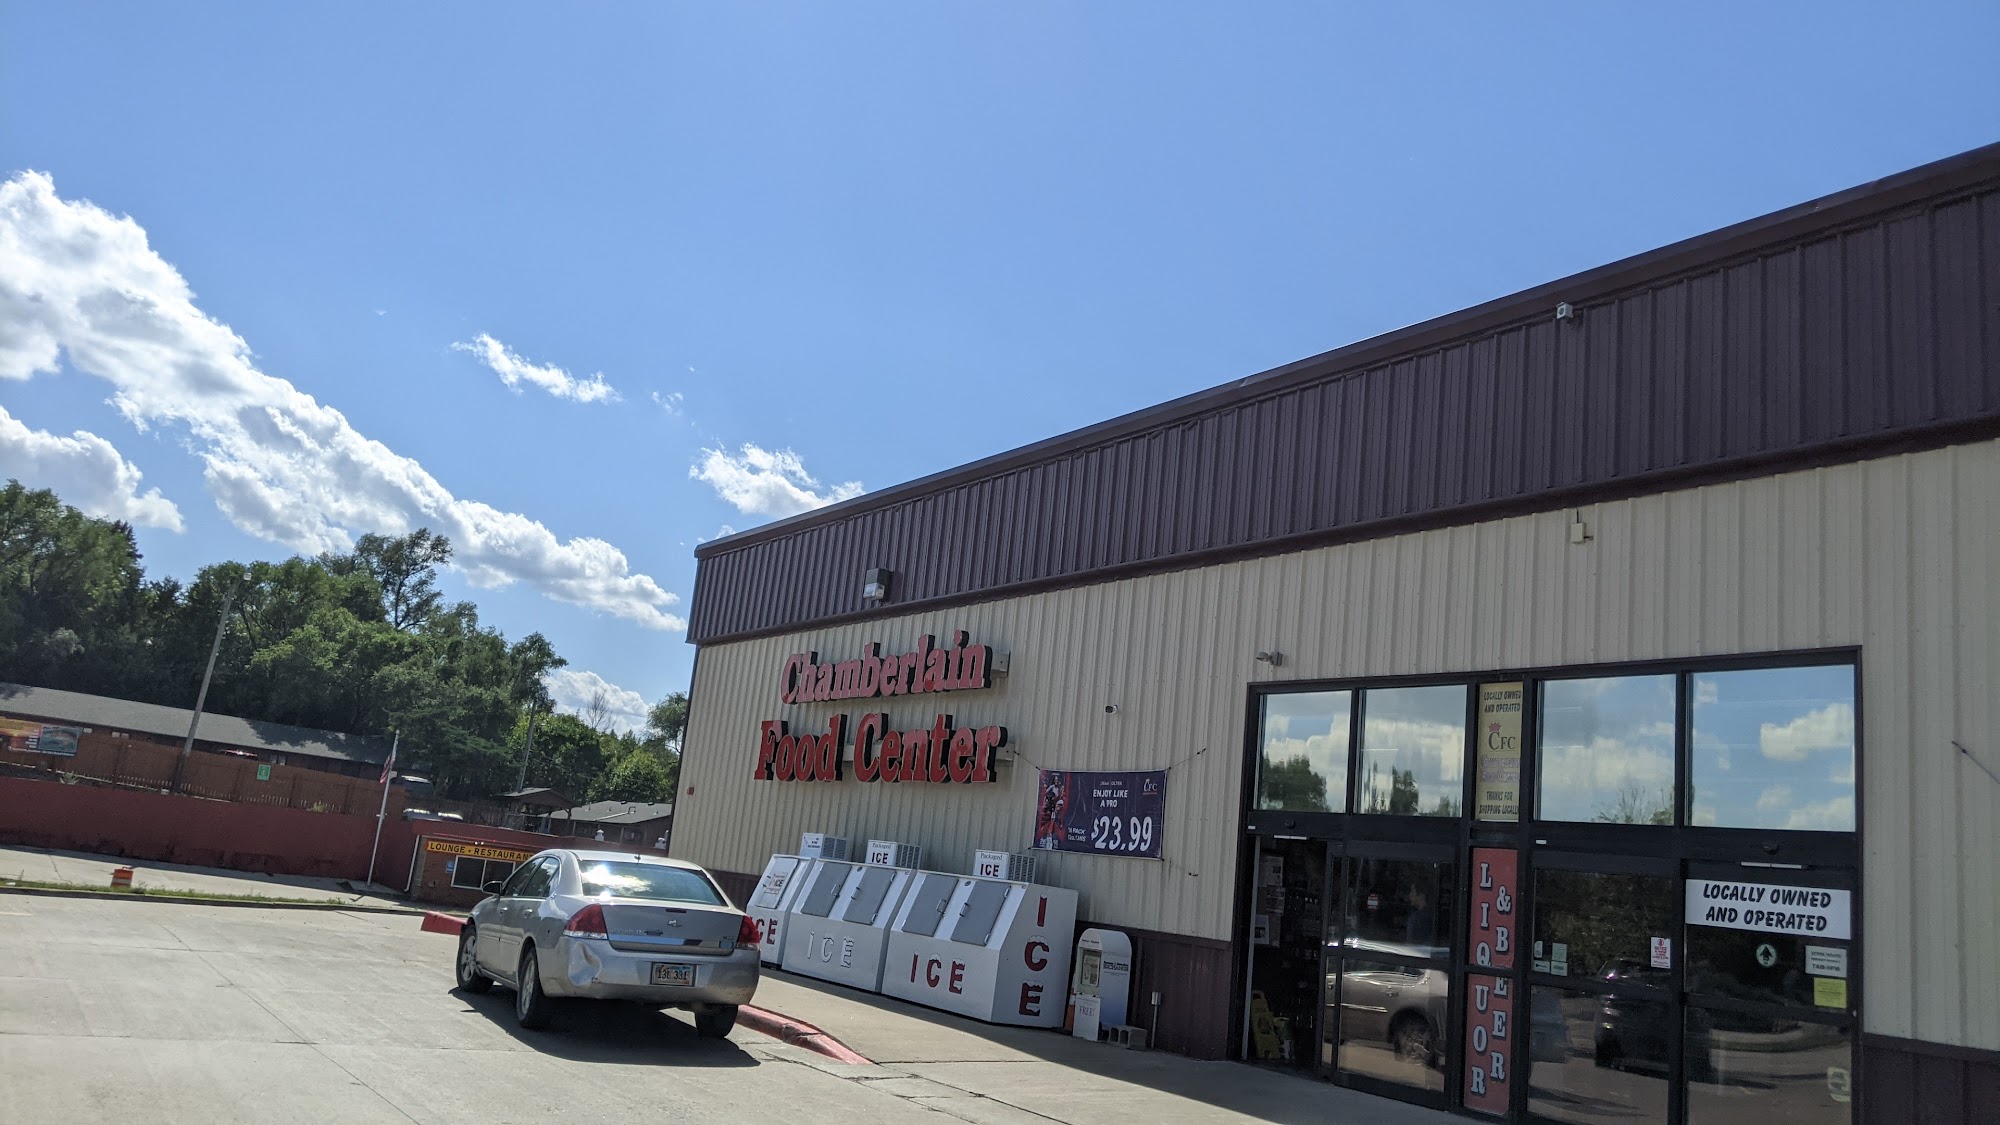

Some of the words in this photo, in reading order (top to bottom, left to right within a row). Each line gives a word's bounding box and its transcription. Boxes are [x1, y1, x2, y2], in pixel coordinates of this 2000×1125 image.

[781, 630, 988, 704] Chamberlain
[1484, 691, 1503, 700] LOCALLY
[1504, 690, 1521, 700] OWNED
[1484, 704, 1495, 713] AND
[1496, 703, 1520, 713] OPERATED
[754, 714, 845, 782] Food
[853, 713, 1005, 783] Center
[1489, 732, 1516, 750] CFC
[1093, 789, 1112, 798] ENJOY
[1113, 789, 1128, 798] LIKE
[1100, 800, 1106, 808] A
[1106, 800, 1118, 808] PRO
[1486, 791, 1503, 801] THANKS
[1504, 791, 1514, 801] FOR
[1479, 804, 1501, 814] SHOPPING
[1091, 815, 1152, 852] $23.99
[430, 842, 465, 853] LOUNGE
[871, 853, 889, 865] ICE
[980, 852, 1003, 860] Packaged
[980, 863, 1000, 877] ICE
[1496, 886, 1511, 912] &
[1703, 883, 1766, 903] LOCALLY
[1770, 888, 1831, 908] OWNED
[750, 916, 778, 945] CE
[1706, 906, 1738, 923] AND
[1743, 909, 1827, 931] OPERATED
[807, 930, 855, 969] ICE
[1019, 892, 1050, 1017] ICE
[910, 949, 965, 995] ICE
[1471, 863, 1492, 1094] LIQUOR
[1491, 926, 1509, 1080] BEER
